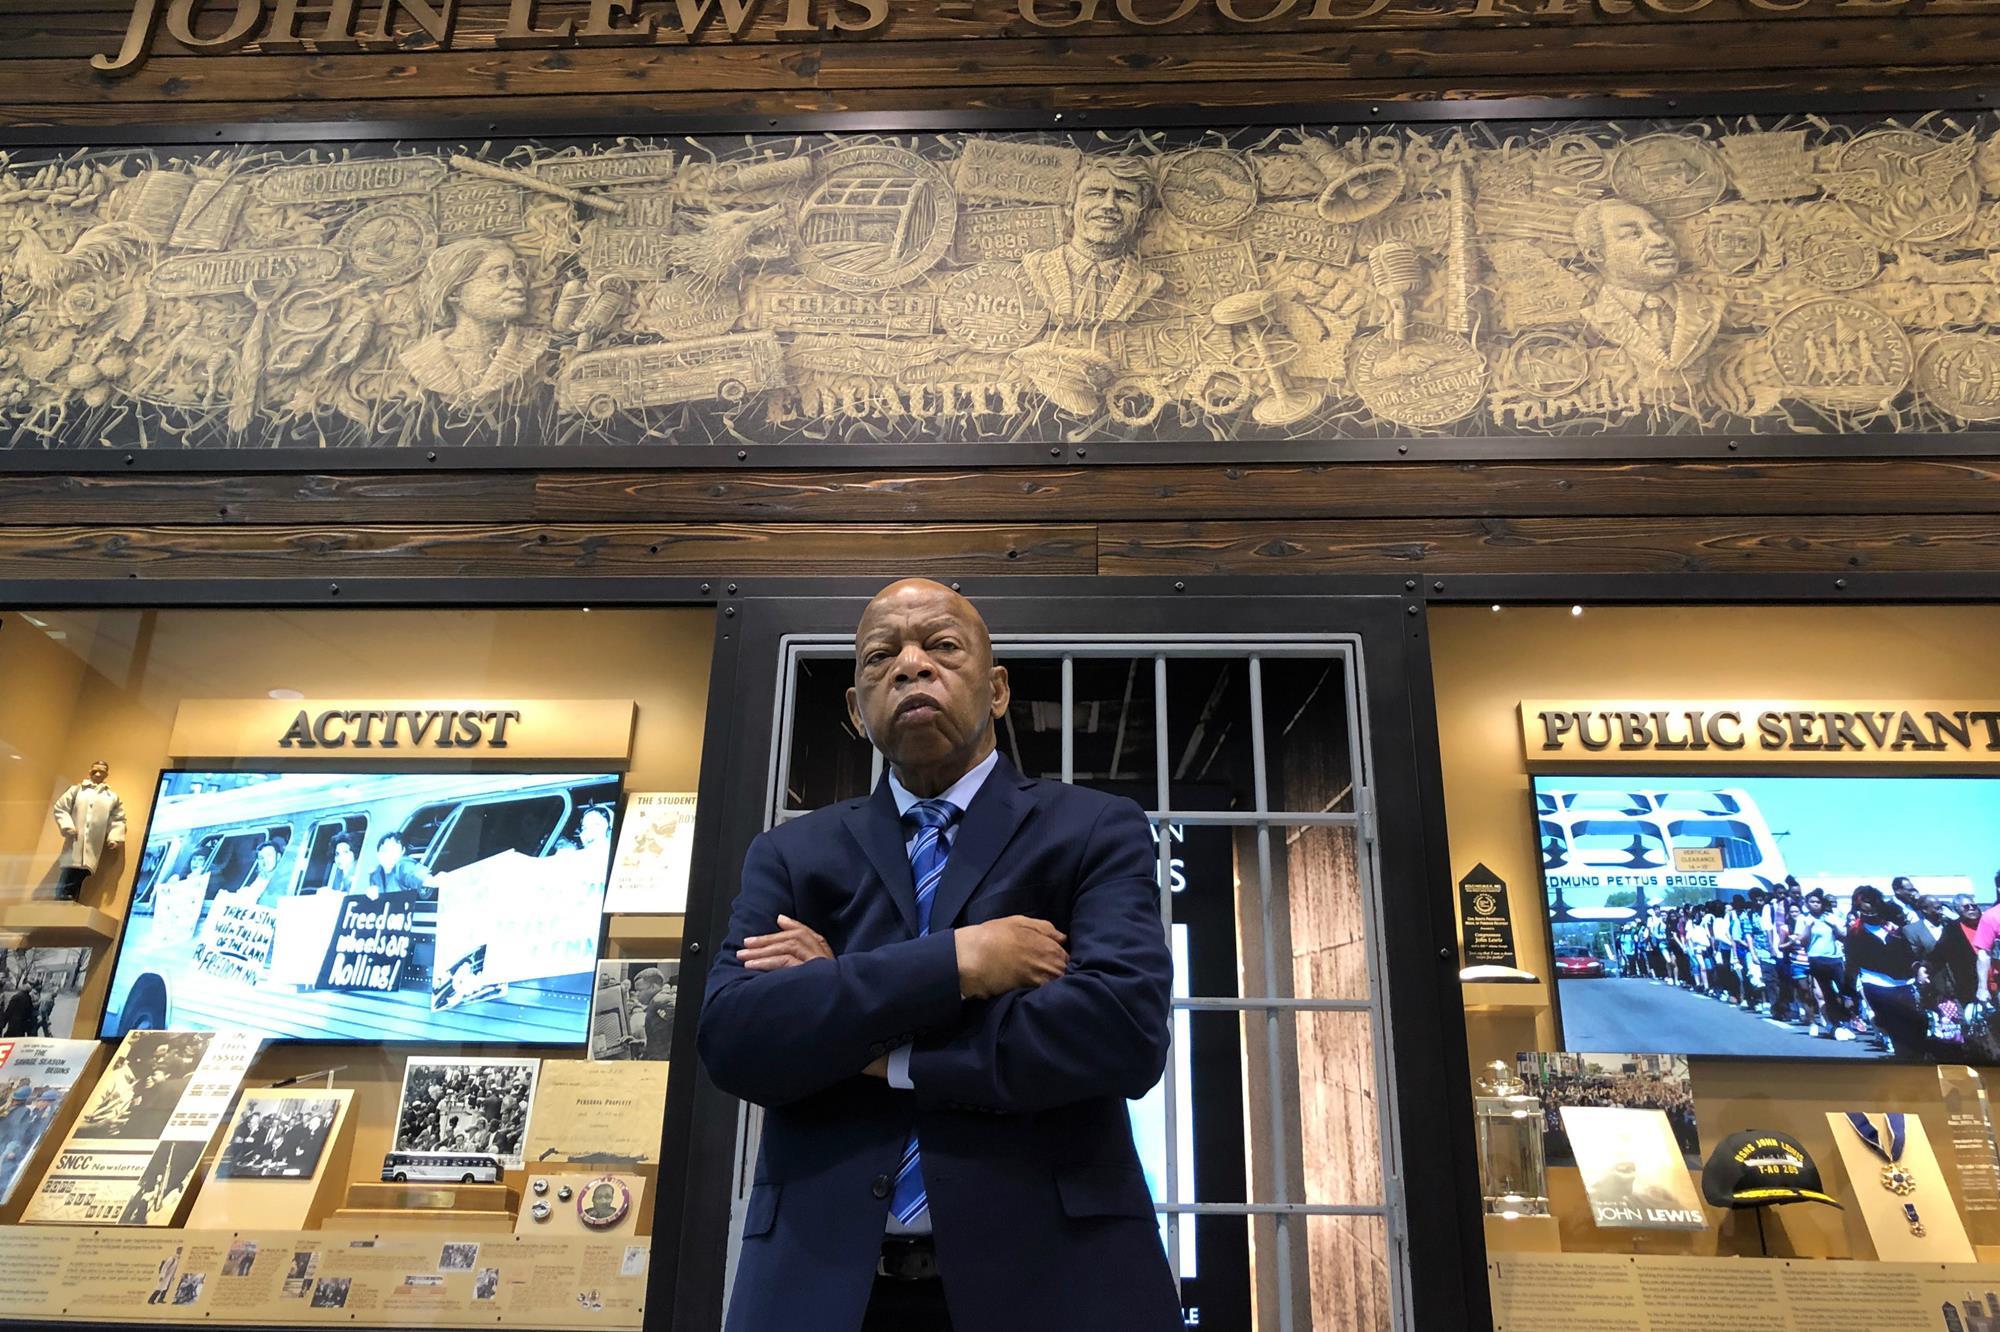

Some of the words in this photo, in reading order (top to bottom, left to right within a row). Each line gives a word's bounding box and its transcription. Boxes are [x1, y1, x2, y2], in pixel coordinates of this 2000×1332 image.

[442, 199, 508, 219] RIGHTS
[951, 265, 991, 291] ONE
[964, 291, 1020, 315] SNCC
[1814, 302, 1884, 328] RIGHTS
[985, 319, 1033, 348] VOTE
[279, 709, 520, 749] ACTIVIST
[1539, 710, 1747, 751] PUBLIC
[1758, 709, 2000, 751] SERVANT
[638, 796, 653, 805] THE
[657, 796, 697, 805] STUDENT
[1545, 875, 1600, 888] DMUND
[1607, 875, 1658, 887] PETTUS
[1666, 875, 1719, 887] BRIDGE
[56, 1155, 94, 1170] SNCC
[1596, 1207, 1643, 1222] JOHN
[1646, 1207, 1704, 1222] LEWIS
